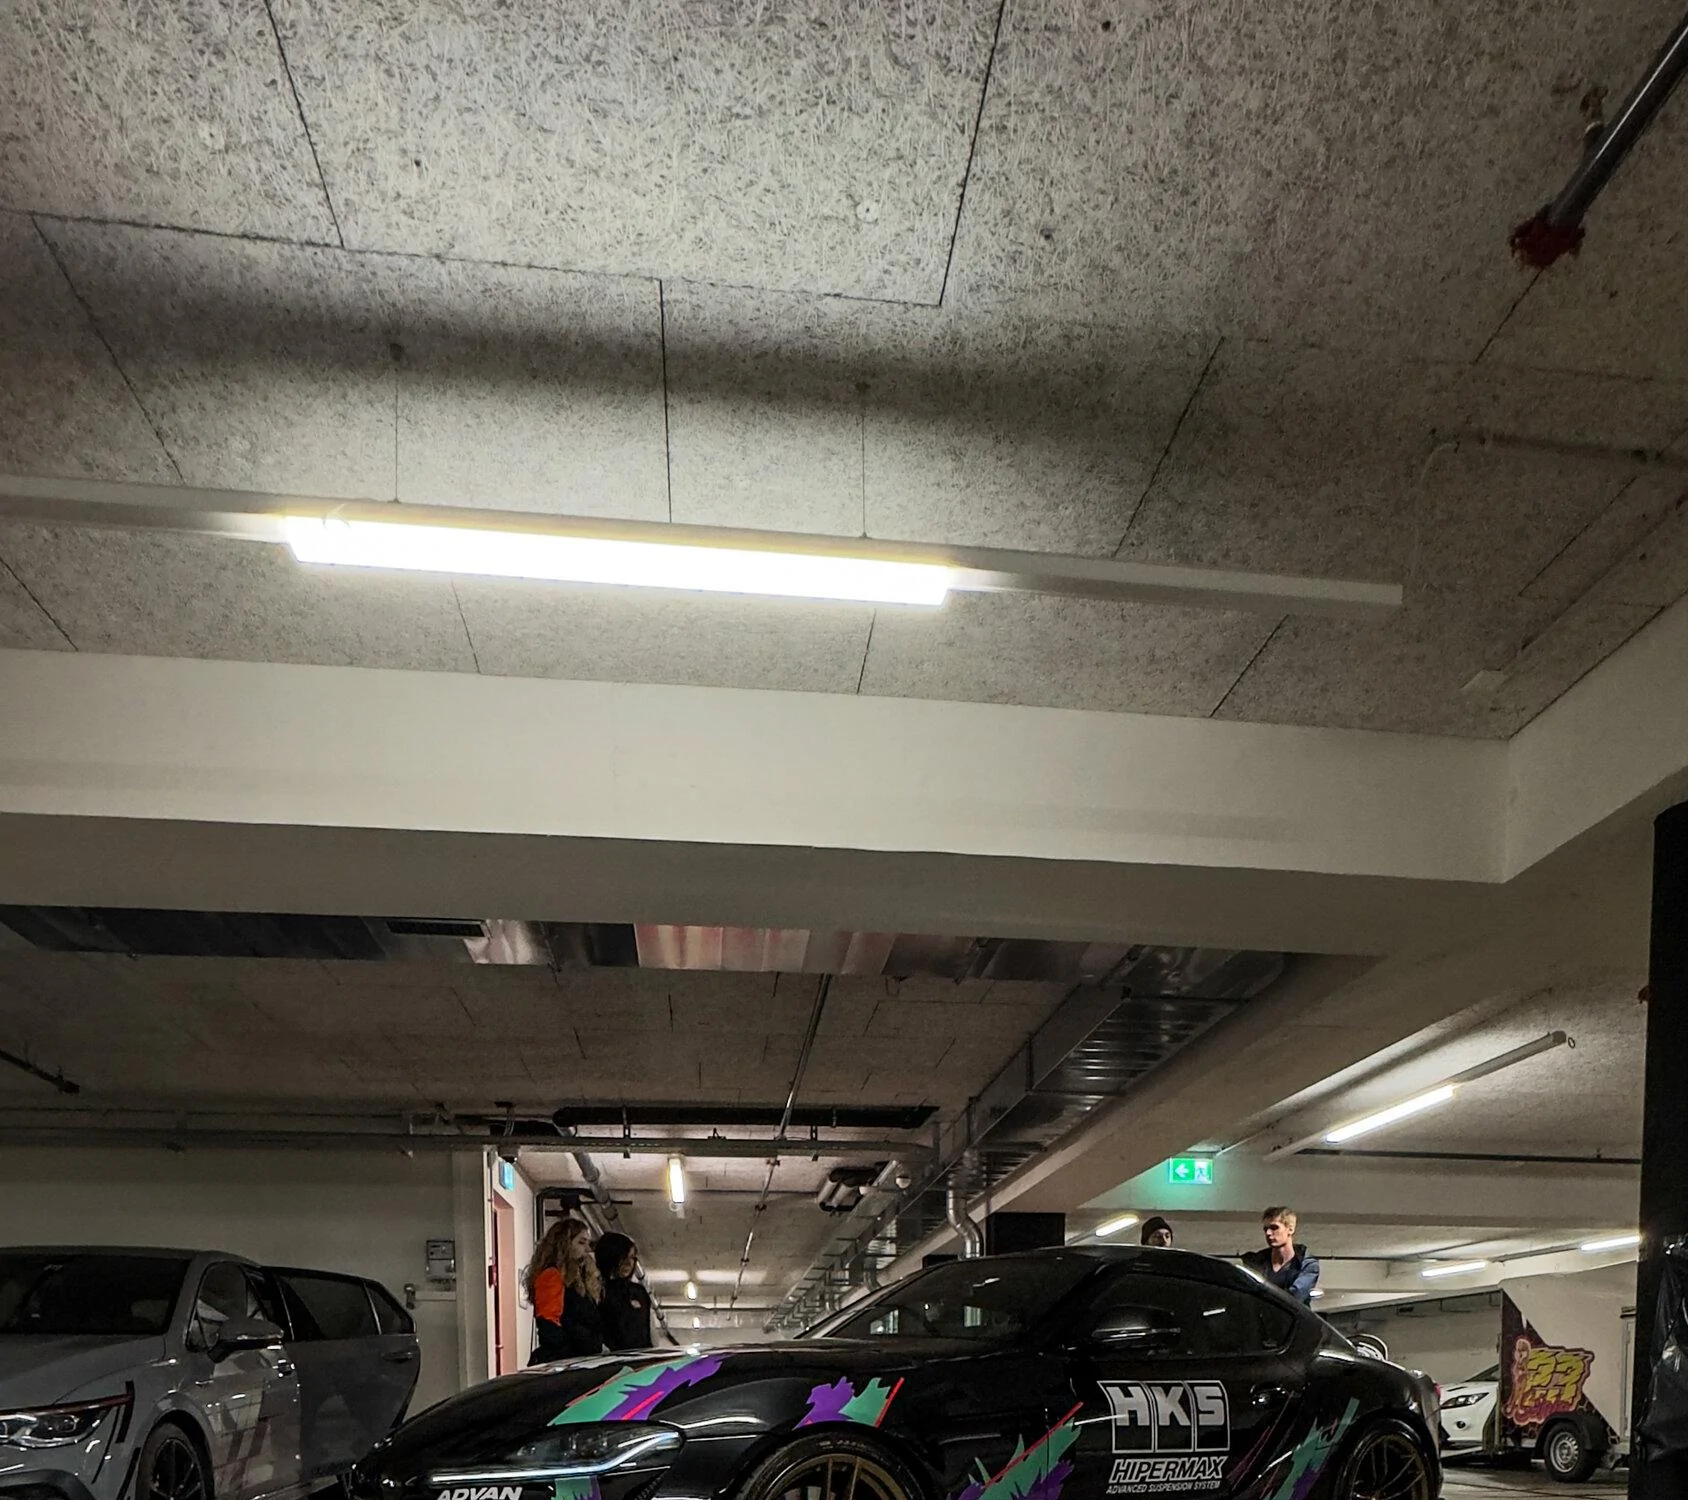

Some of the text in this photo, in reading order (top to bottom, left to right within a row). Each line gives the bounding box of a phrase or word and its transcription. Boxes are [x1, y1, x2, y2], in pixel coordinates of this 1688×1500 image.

[1104, 1384, 1227, 1428] HKS
[1108, 1456, 1228, 1484] HIPERMAX
[1106, 1480, 1221, 1495] ADVANCED SUSPENSION SYSTEM
